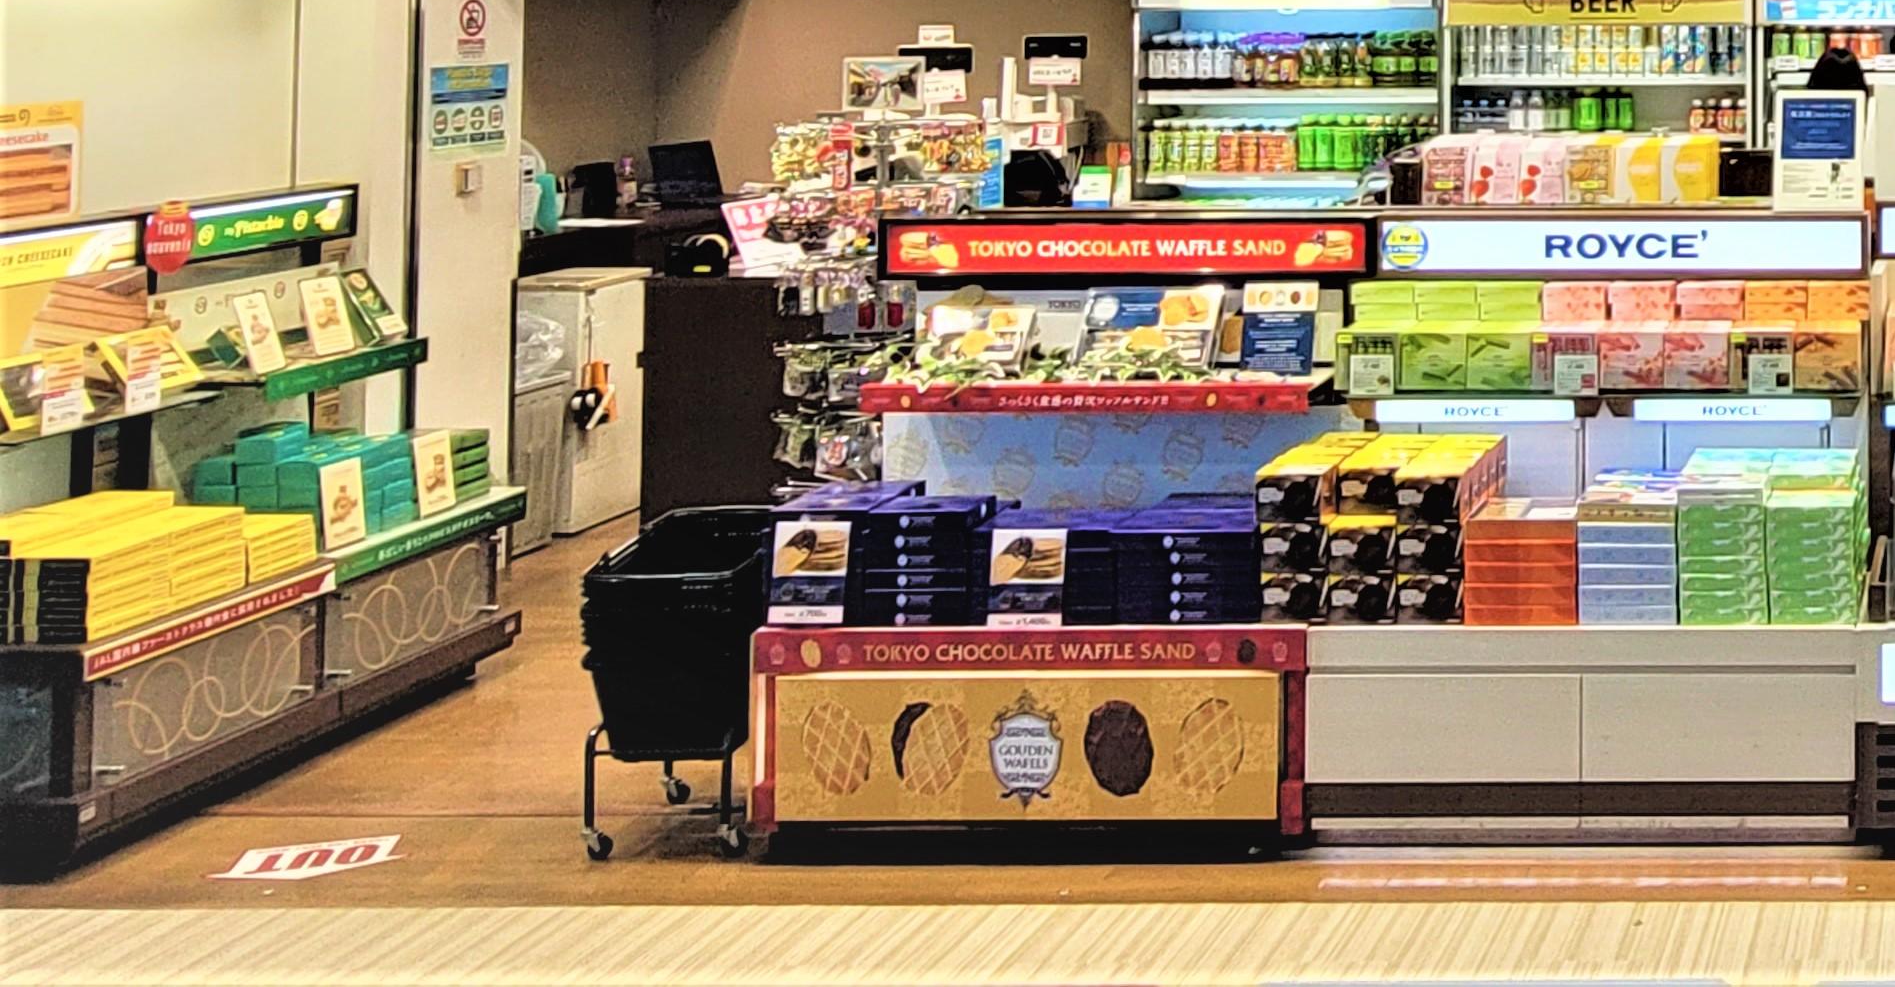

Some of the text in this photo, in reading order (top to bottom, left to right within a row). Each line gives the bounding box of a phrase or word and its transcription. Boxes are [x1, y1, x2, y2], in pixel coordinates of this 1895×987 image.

[157, 220, 187, 236] Tokyo
[968, 239, 1287, 258] TOKYO CHOCOLATE WAFFLE SAND
[1544, 229, 1708, 259] ROYCE'
[863, 642, 1196, 662] TOKYO CHOCOLATE WAFFLE SAND
[998, 743, 1054, 756] GOUDEN
[243, 844, 381, 875] OUT
